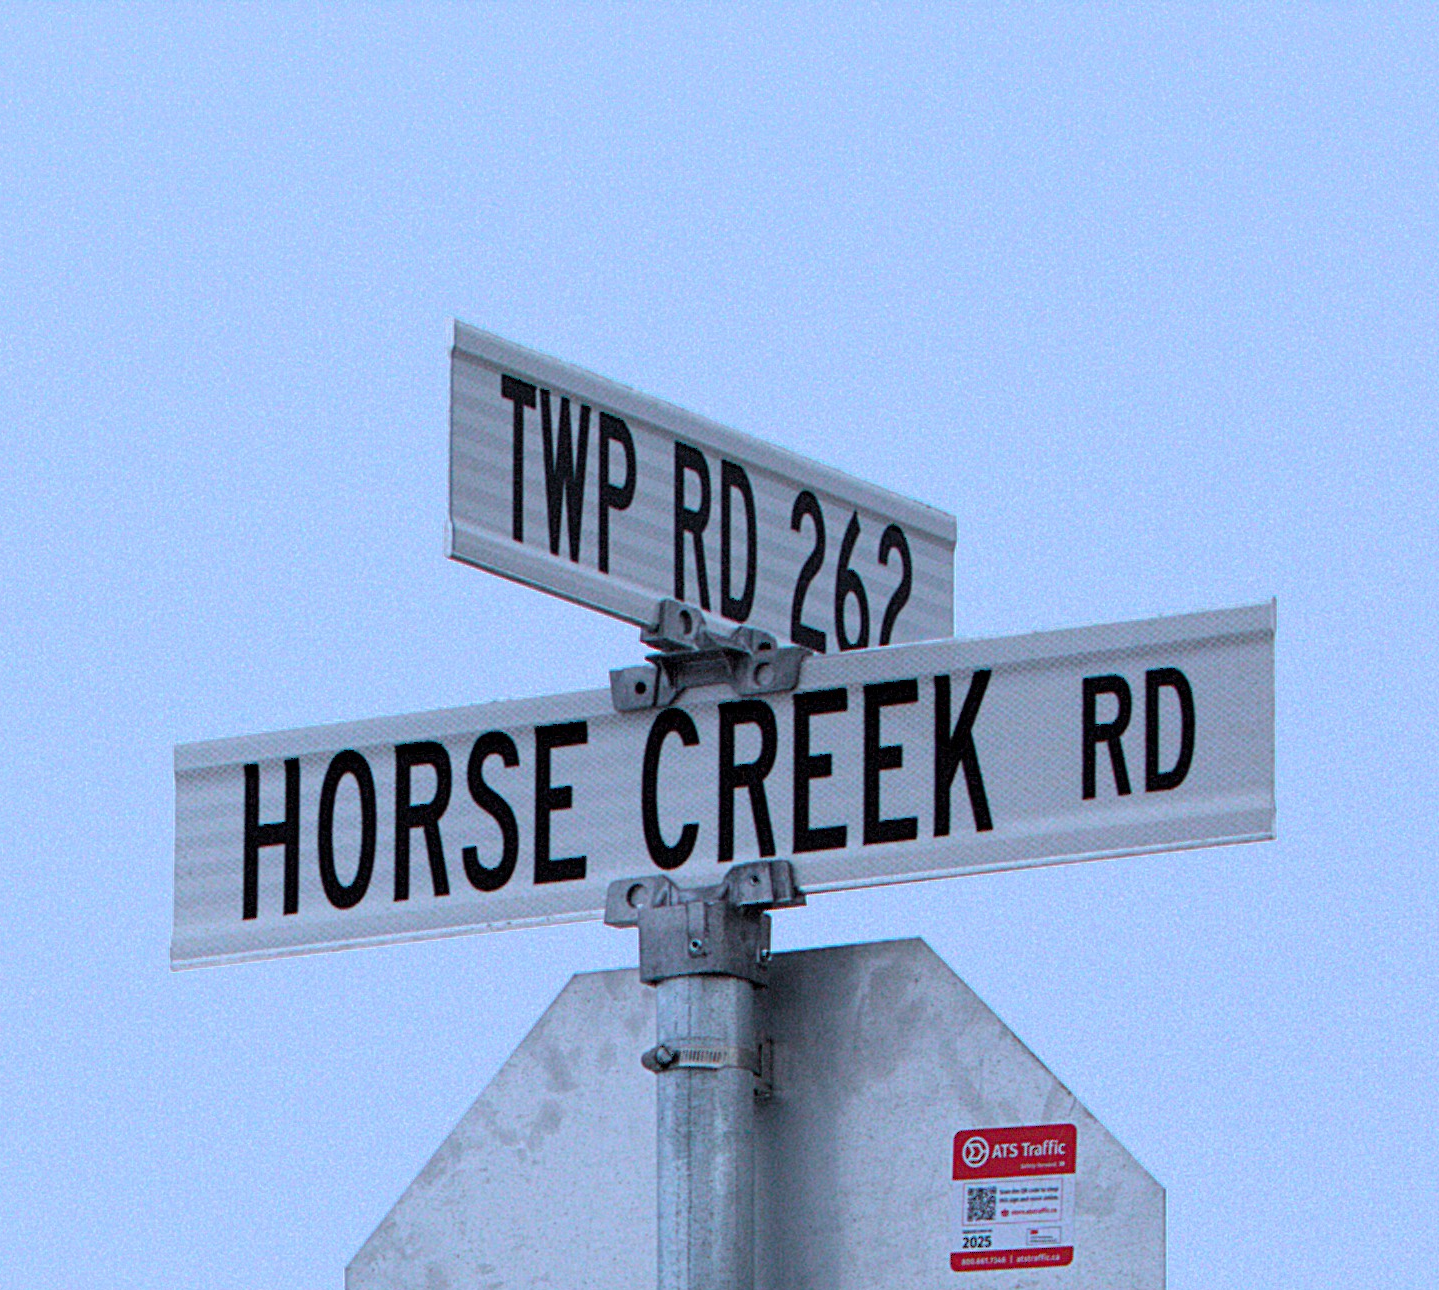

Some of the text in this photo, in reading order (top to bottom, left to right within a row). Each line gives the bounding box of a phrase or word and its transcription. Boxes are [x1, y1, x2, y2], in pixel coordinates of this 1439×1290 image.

[501, 374, 912, 653] TWP RD 262
[242, 667, 1195, 920] HORSE CREEK RD
[991, 1139, 1066, 1159] ATS Traffic
[962, 1236, 992, 1249] 2025
